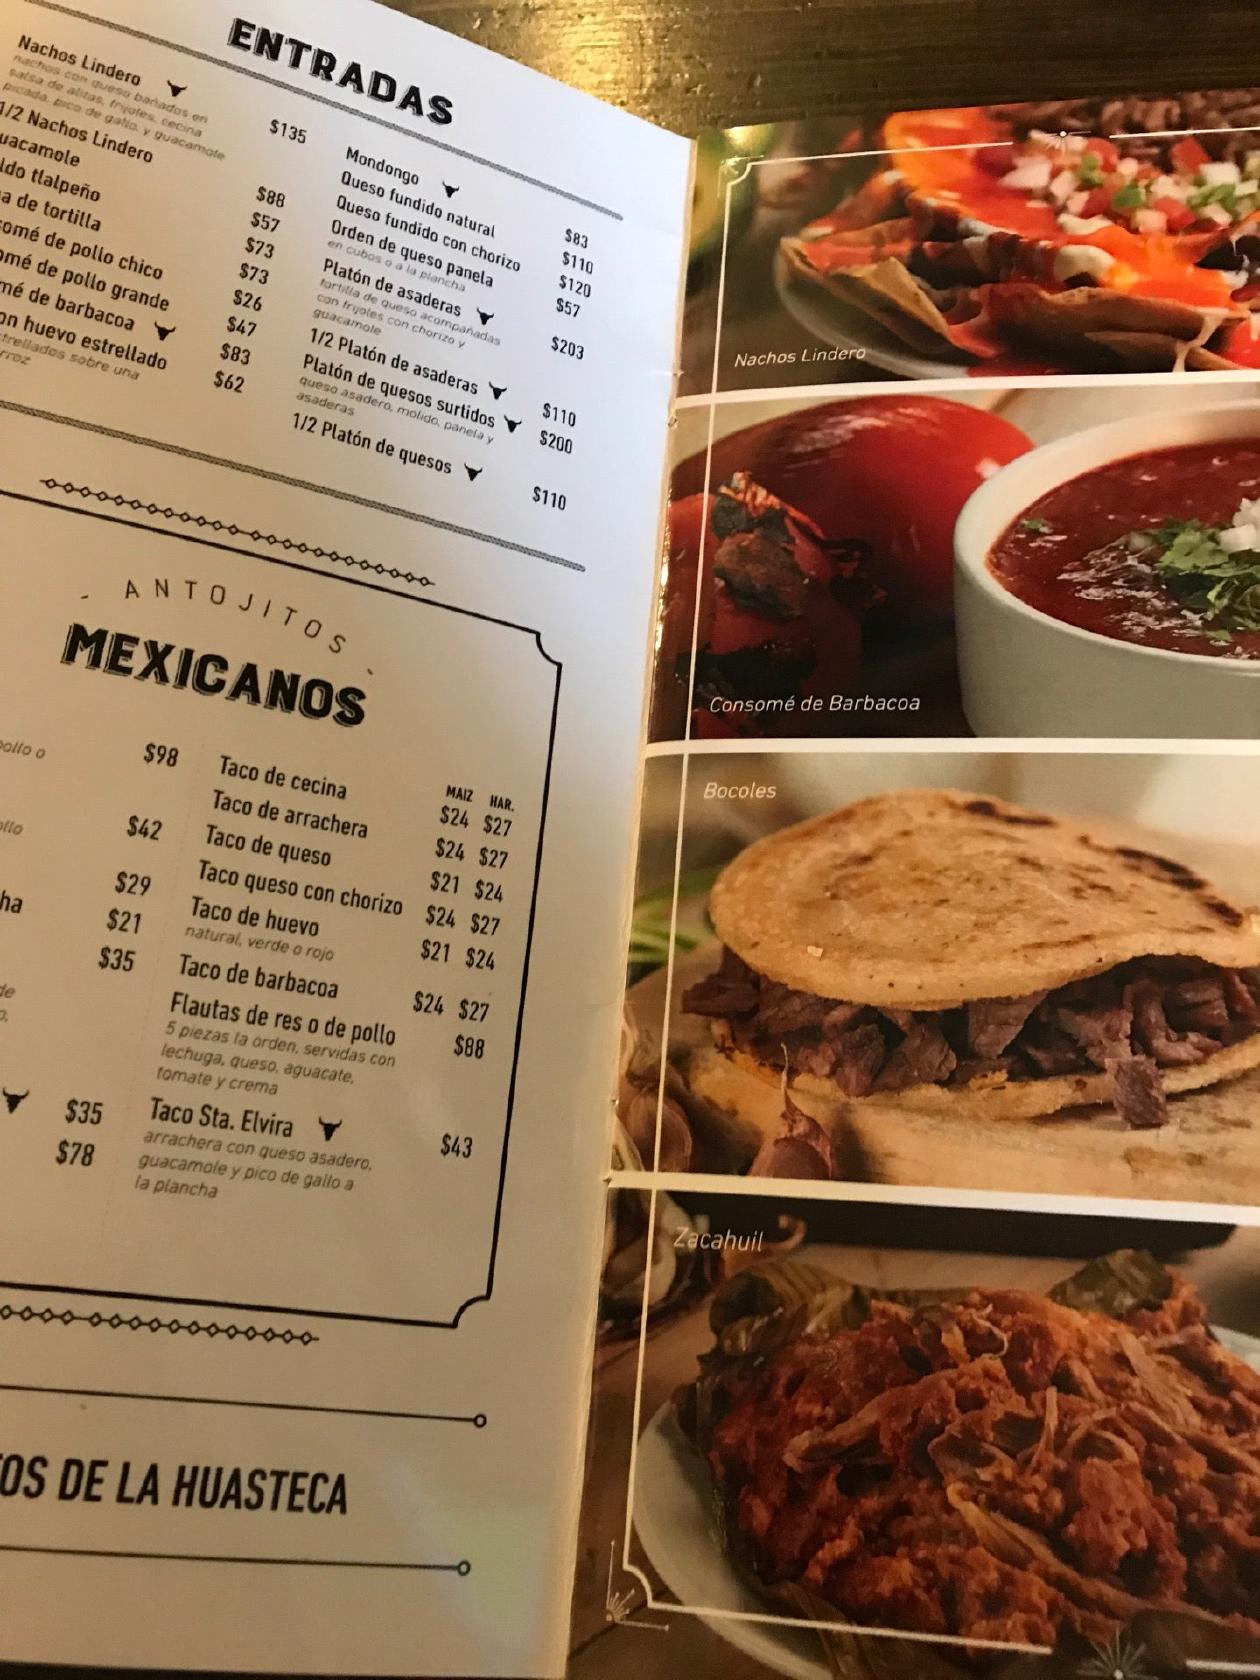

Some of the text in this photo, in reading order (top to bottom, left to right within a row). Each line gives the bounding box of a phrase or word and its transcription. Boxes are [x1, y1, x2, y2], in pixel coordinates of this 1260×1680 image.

[17, 34, 141, 86] Nachos Lindero
[227, 18, 453, 124] ENTRADAS
[26, 109, 88, 142] Nachos
[92, 130, 153, 163] Lindero
[270, 119, 307, 144] $135
[345, 146, 419, 185] Mondongo
[30, 168, 101, 202] tlalpeño
[256, 186, 285, 208] $88
[16, 193, 101, 232] de tortilla
[340, 170, 495, 238] Queso fundido natural
[251, 211, 280, 233] $57
[336, 194, 521, 272] Queso fundido con chorizo
[245, 237, 275, 259] $73
[331, 219, 493, 287] Orden de queso panela
[564, 228, 588, 249] $83
[44, 231, 163, 280] de pollo chico
[562, 251, 593, 274] $110
[36, 259, 169, 311] de pollo grande
[239, 262, 269, 285] $73
[323, 257, 461, 317] Platón de asaderas
[559, 275, 591, 298] $120
[28, 287, 135, 331] de barbacoa
[233, 289, 262, 311] $26
[556, 298, 580, 318] $57
[23, 314, 167, 370] huevo estrellado
[227, 316, 257, 337] $47
[220, 343, 250, 365] $83
[311, 327, 478, 395] 1/2 Platón de asaderas
[551, 336, 584, 360] $203
[735, 346, 866, 367] Nachos Lindero
[213, 370, 244, 393] $62
[303, 353, 495, 428] Platón de quesos surtidos
[542, 402, 576, 427] $110
[293, 412, 452, 474] 1/2 Platón de quesos
[539, 430, 573, 454] $200
[532, 487, 566, 511] $110
[125, 579, 346, 653] ANTOJITOS
[60, 623, 366, 727] MEXICANOS
[710, 694, 920, 713] Consomé de Barbacoa
[144, 742, 179, 767] $98
[220, 754, 347, 800] Taco de cecina
[703, 782, 776, 799] Bocoles
[213, 788, 368, 839] Taco de arrachera
[446, 785, 514, 812] MAIZ HAR.
[126, 815, 162, 841] $42
[440, 805, 512, 837] $24 $27
[206, 823, 331, 866] Taco de queso
[435, 837, 508, 869] $24 $27
[115, 871, 151, 896] $29
[199, 859, 403, 916] Taco queso con chorizo
[430, 871, 503, 902] $21 $24
[107, 908, 141, 934] $21
[192, 895, 319, 937] Taco de huevo
[426, 904, 500, 936] $24 $27
[98, 946, 136, 972] $35
[421, 939, 495, 971] $21 $24
[180, 953, 339, 999] Taco de barbacoa
[170, 991, 396, 1046] Flautas de res o de pollo
[413, 990, 489, 1023] $24 $27
[165, 1020, 396, 1067] 5 piezas la orden, servidas con
[454, 1034, 485, 1060] $88
[160, 1043, 354, 1085] lechuga, queso, aguacate,
[156, 1066, 279, 1095] tomate y crema
[65, 1097, 103, 1125] $35
[150, 1097, 294, 1138] Taco Sta. Elvira
[56, 1139, 95, 1166] $78
[143, 1130, 372, 1171] arrachera con queso asadero,
[441, 1133, 473, 1158] $43
[134, 1174, 218, 1199] la plancha
[138, 1154, 354, 1191] guacamole y pico de gallo a
[673, 1226, 764, 1252] Zacahuil
[58, 1458, 347, 1515] DE LA HUASTECA
